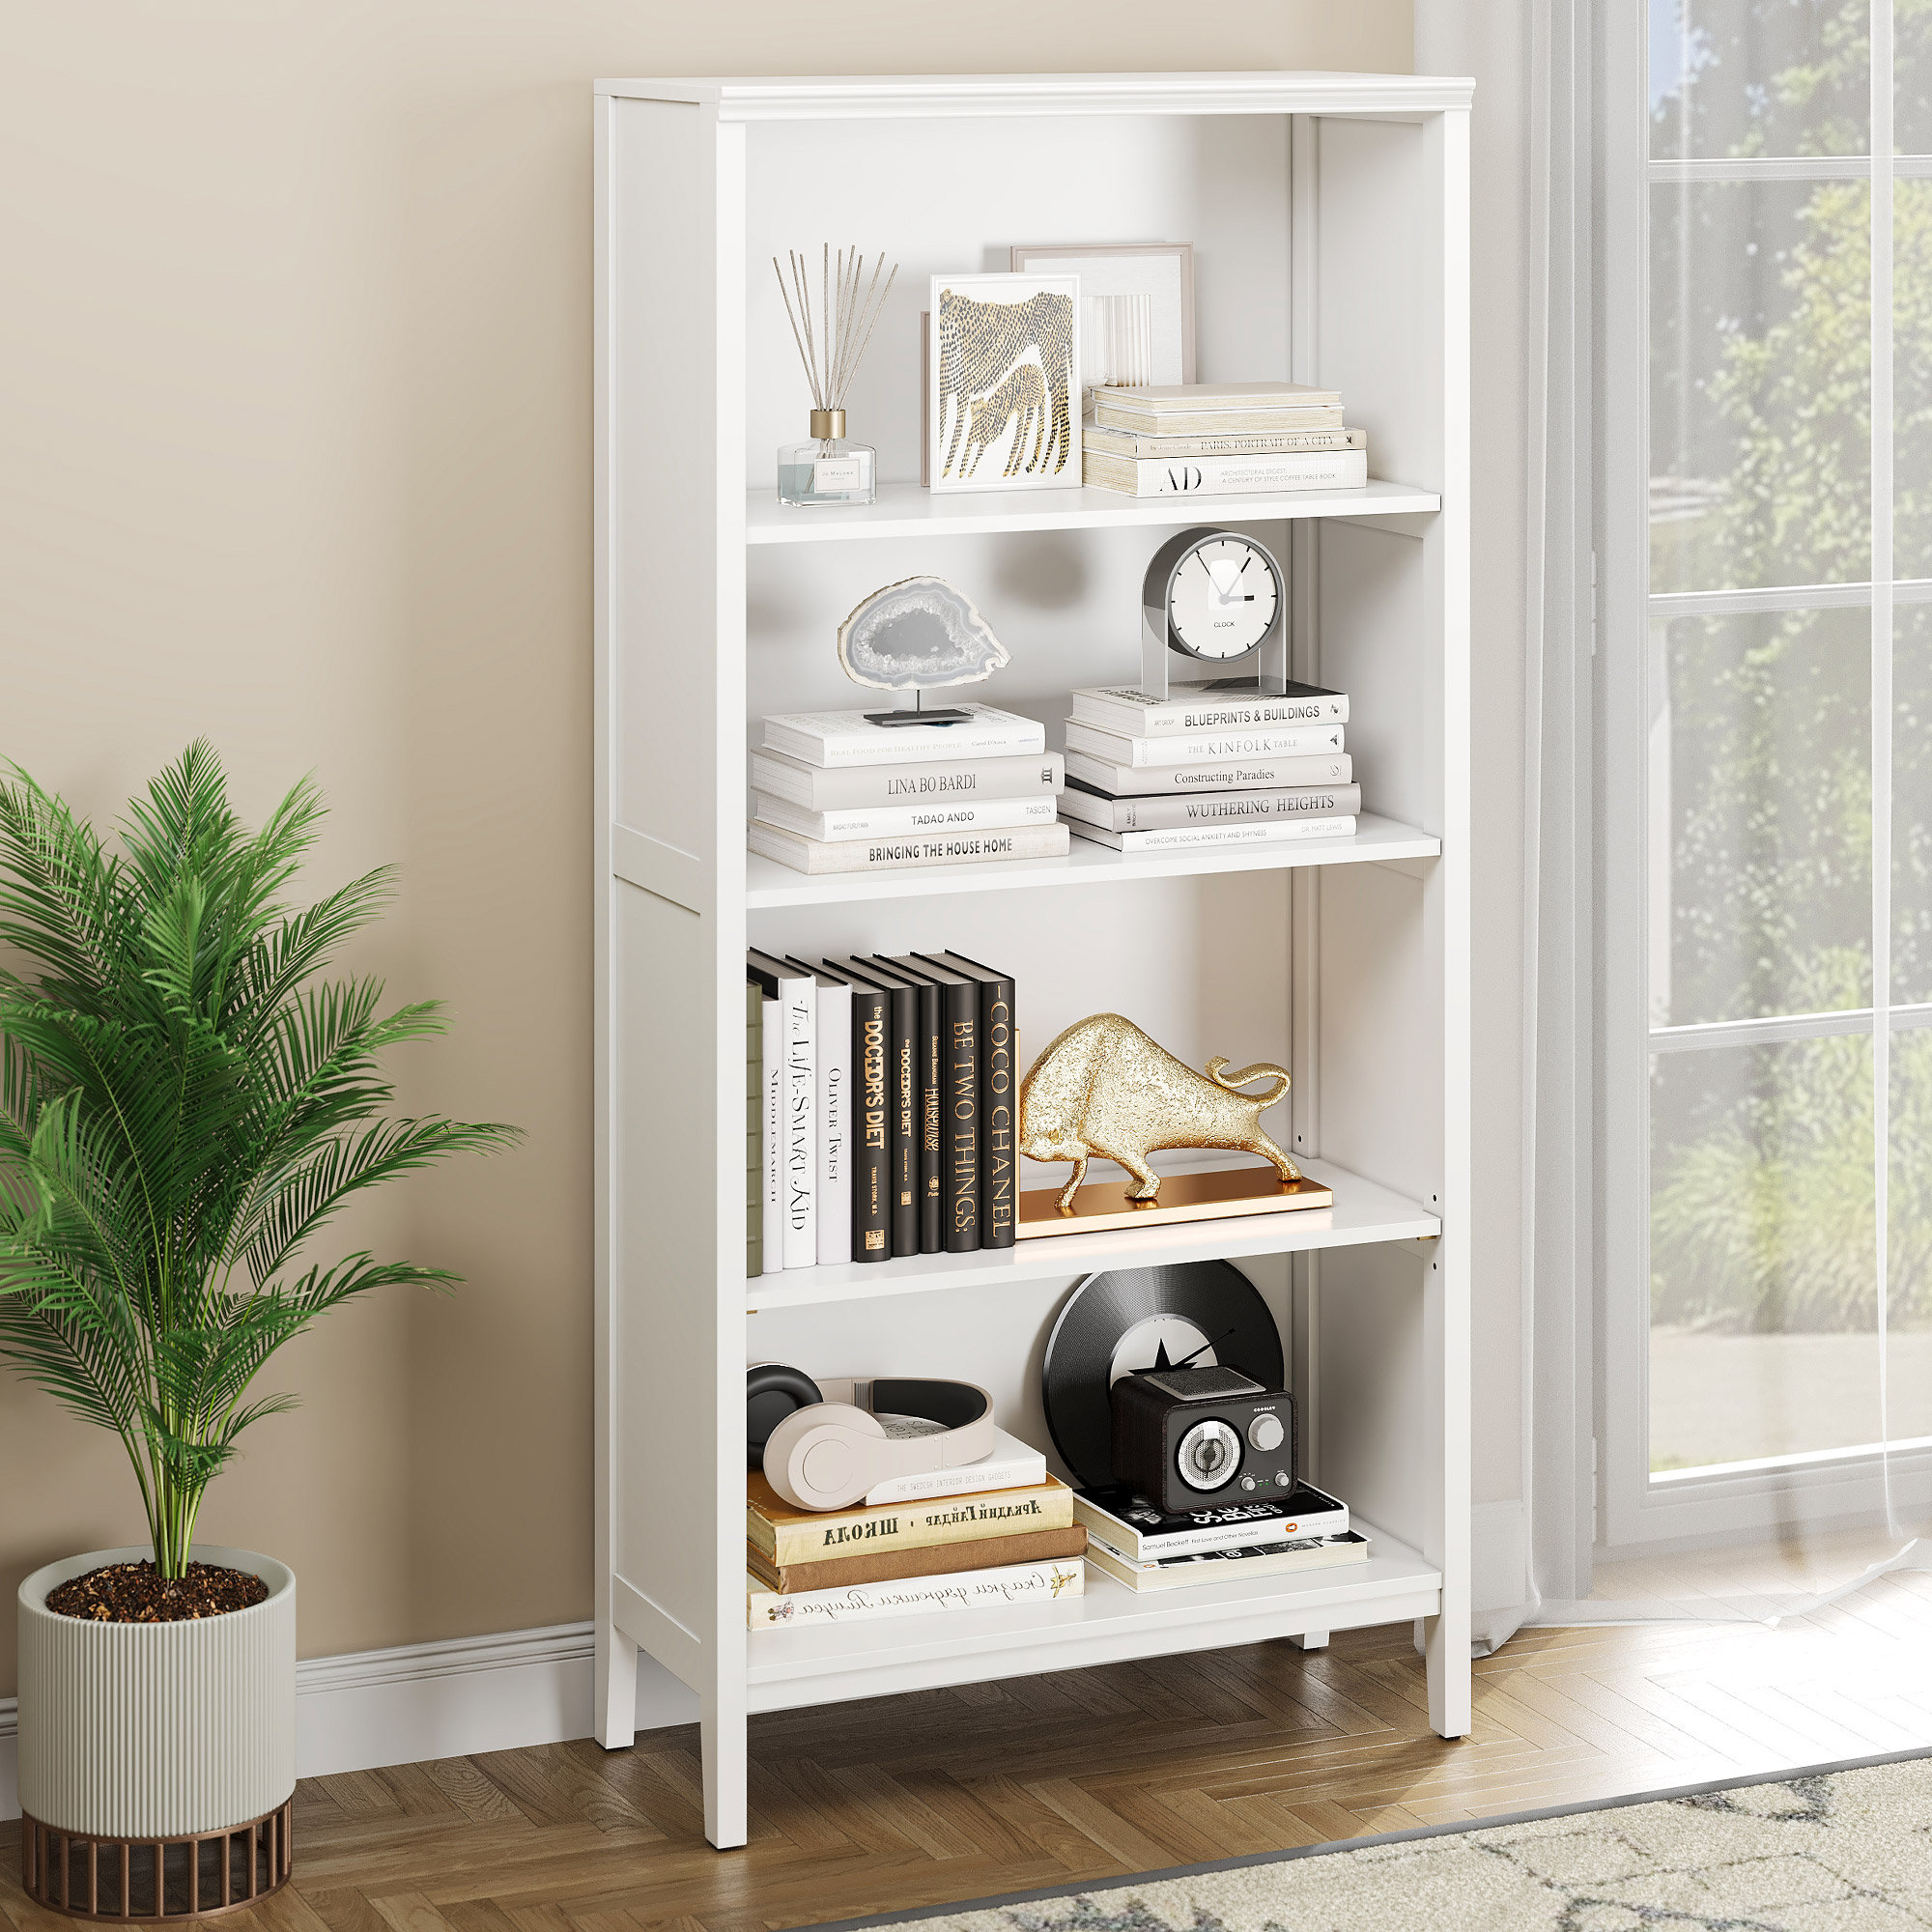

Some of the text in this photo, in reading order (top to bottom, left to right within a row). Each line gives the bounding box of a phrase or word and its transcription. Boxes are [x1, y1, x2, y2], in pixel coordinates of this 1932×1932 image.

[1235, 438, 1285, 448] PORTRAIT
[1287, 437, 1300, 446] OF
[1311, 436, 1335, 445] CITY
[1159, 466, 1202, 492] AD
[1184, 705, 1321, 727] BLUEPRINTS & BUILDINGS
[894, 744, 930, 753] HEALTHY
[1187, 738, 1298, 754] THE KINFOLK TABLE
[888, 774, 977, 795] LINA BO BARDI
[1175, 770, 1275, 784] Constructing Paradies
[1186, 794, 1334, 818] WUTHERING HEIGHTS
[911, 811, 975, 826] TADAO ANDO
[1145, 836, 1179, 845] OVERCOME
[1179, 834, 1201, 843] SOCIAL
[1201, 832, 1227, 841] ANXIETY
[1241, 829, 1267, 838] SHYNESS
[869, 838, 1012, 862] BRINGING THE HOUSE HOME
[873, 1006, 883, 1020] the
[829, 1068, 842, 1183] OLIVER TWIST
[866, 1110, 885, 1150] DIET
[900, 1110, 912, 1137] DIET
[953, 1019, 976, 1233] BE TWO THINGS:
[991, 1105, 1010, 1238] CHANEL
[910, 1482, 933, 1491] SWEDISH
[936, 1477, 962, 1488] INTERIOR
[965, 1474, 985, 1485] DESIGN
[988, 1470, 1011, 1481] GADGETS
[1142, 1541, 1166, 1550] Samuel
[1166, 1539, 1189, 1548] Beckett
